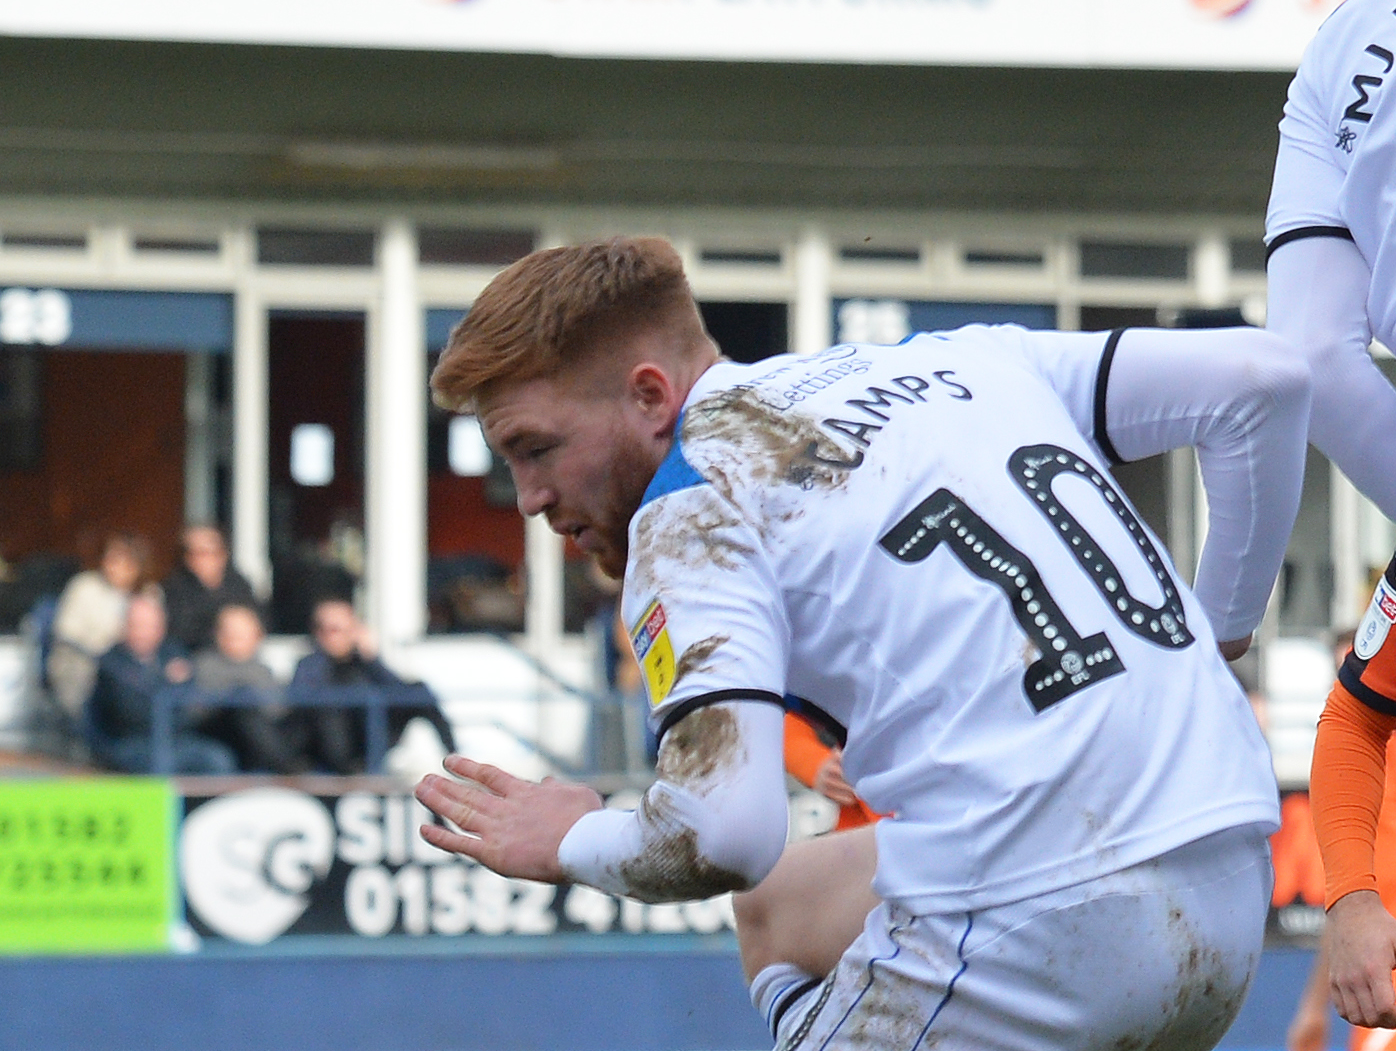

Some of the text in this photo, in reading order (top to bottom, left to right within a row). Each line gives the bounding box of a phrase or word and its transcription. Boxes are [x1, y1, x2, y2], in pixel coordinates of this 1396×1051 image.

[1345, 44, 1395, 124] MJ
[806, 370, 973, 470] CAMPS
[880, 444, 1195, 714] 10
[345, 864, 557, 936] 01582
